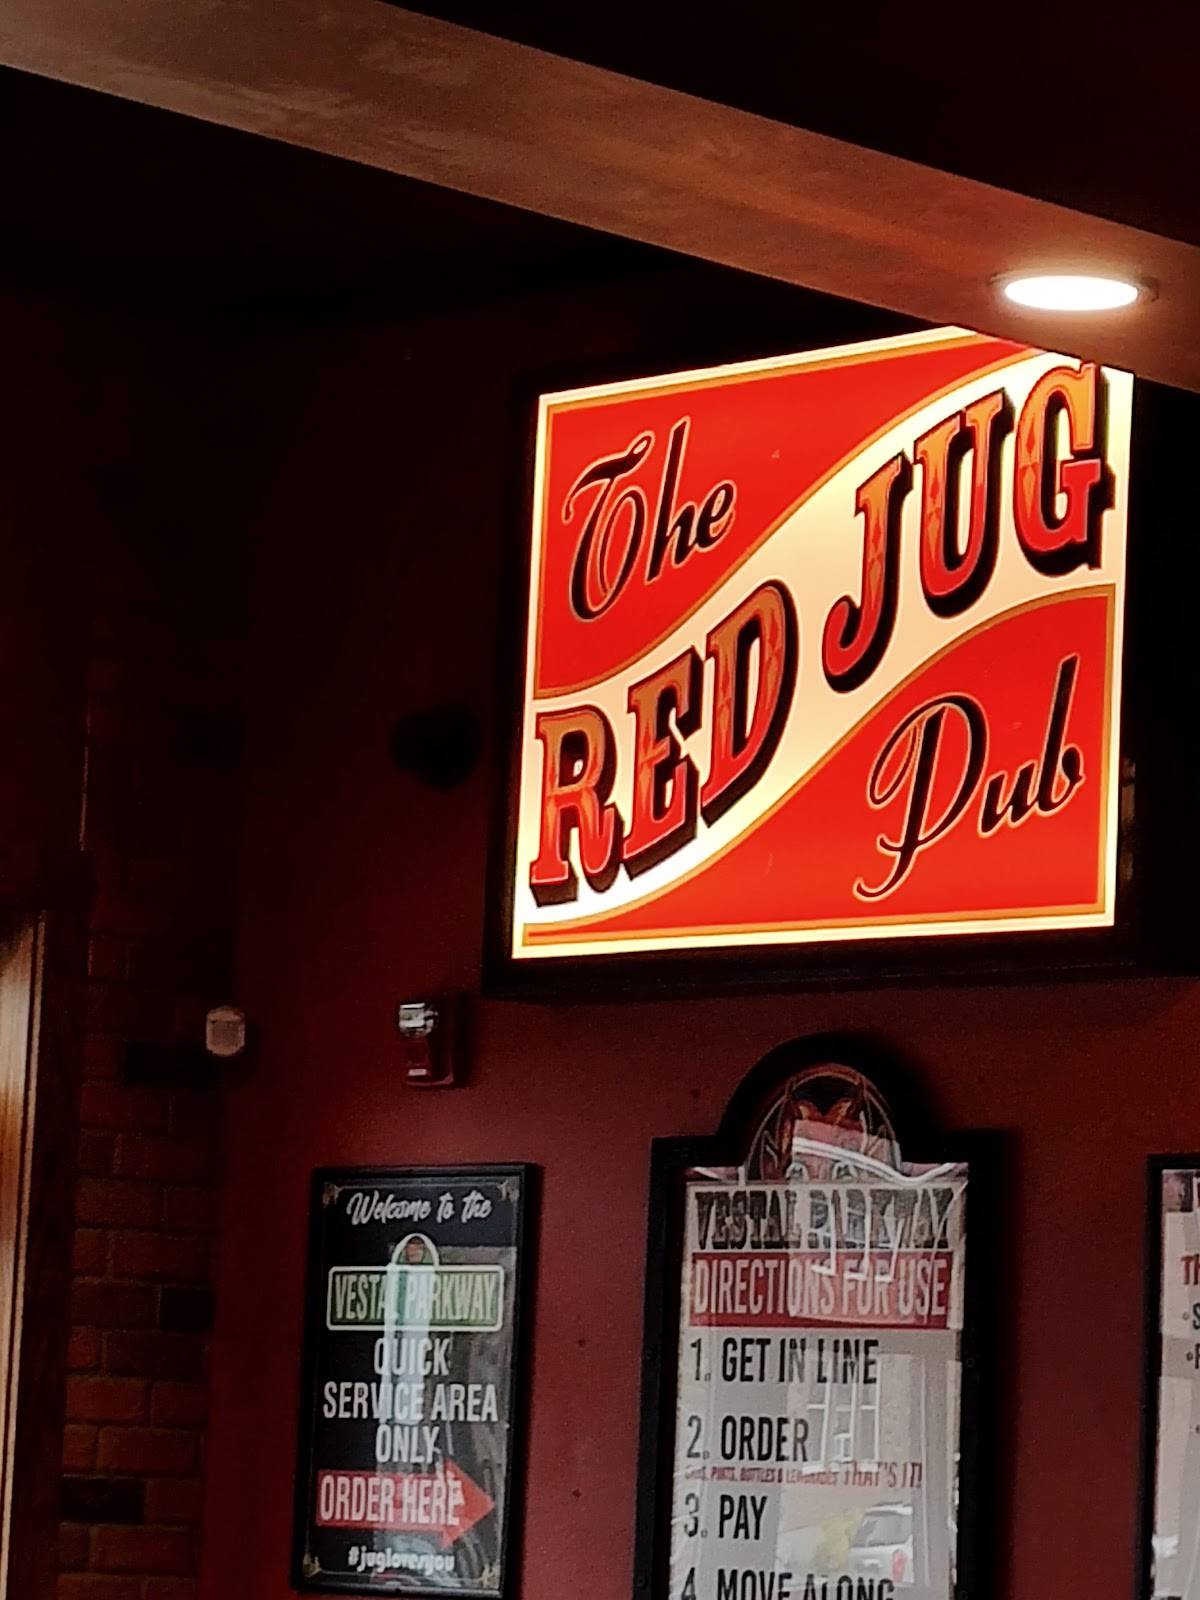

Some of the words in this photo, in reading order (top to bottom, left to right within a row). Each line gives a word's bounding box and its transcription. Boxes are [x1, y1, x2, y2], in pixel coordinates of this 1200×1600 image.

[562, 416, 736, 622] The
[530, 579, 799, 907] RED
[822, 361, 1116, 693] JUG
[853, 652, 1086, 902] Pub
[346, 1190, 431, 1225] Welcome
[437, 1192, 454, 1223] to
[461, 1190, 492, 1223] the
[404, 1274, 497, 1320] PARKWAY
[694, 1257, 835, 1315] DIRECTIONS
[842, 1260, 890, 1316] FOR
[899, 1258, 948, 1317] USE
[374, 1337, 450, 1376] QUICK
[690, 1337, 711, 1382] 1.
[722, 1337, 771, 1383] GET
[778, 1338, 807, 1383] IN
[816, 1338, 879, 1385] LINE
[323, 1381, 425, 1421] SERVICE
[430, 1383, 499, 1422] AREA
[375, 1423, 440, 1464] ONLY
[687, 1415, 709, 1460] 2.
[721, 1415, 809, 1462] ORDER
[319, 1474, 395, 1523] ORDER
[401, 1477, 464, 1526] HERE
[718, 1494, 768, 1540] PAY
[348, 1545, 455, 1576] #juglovesyou
[717, 1568, 793, 1600] MOVE
